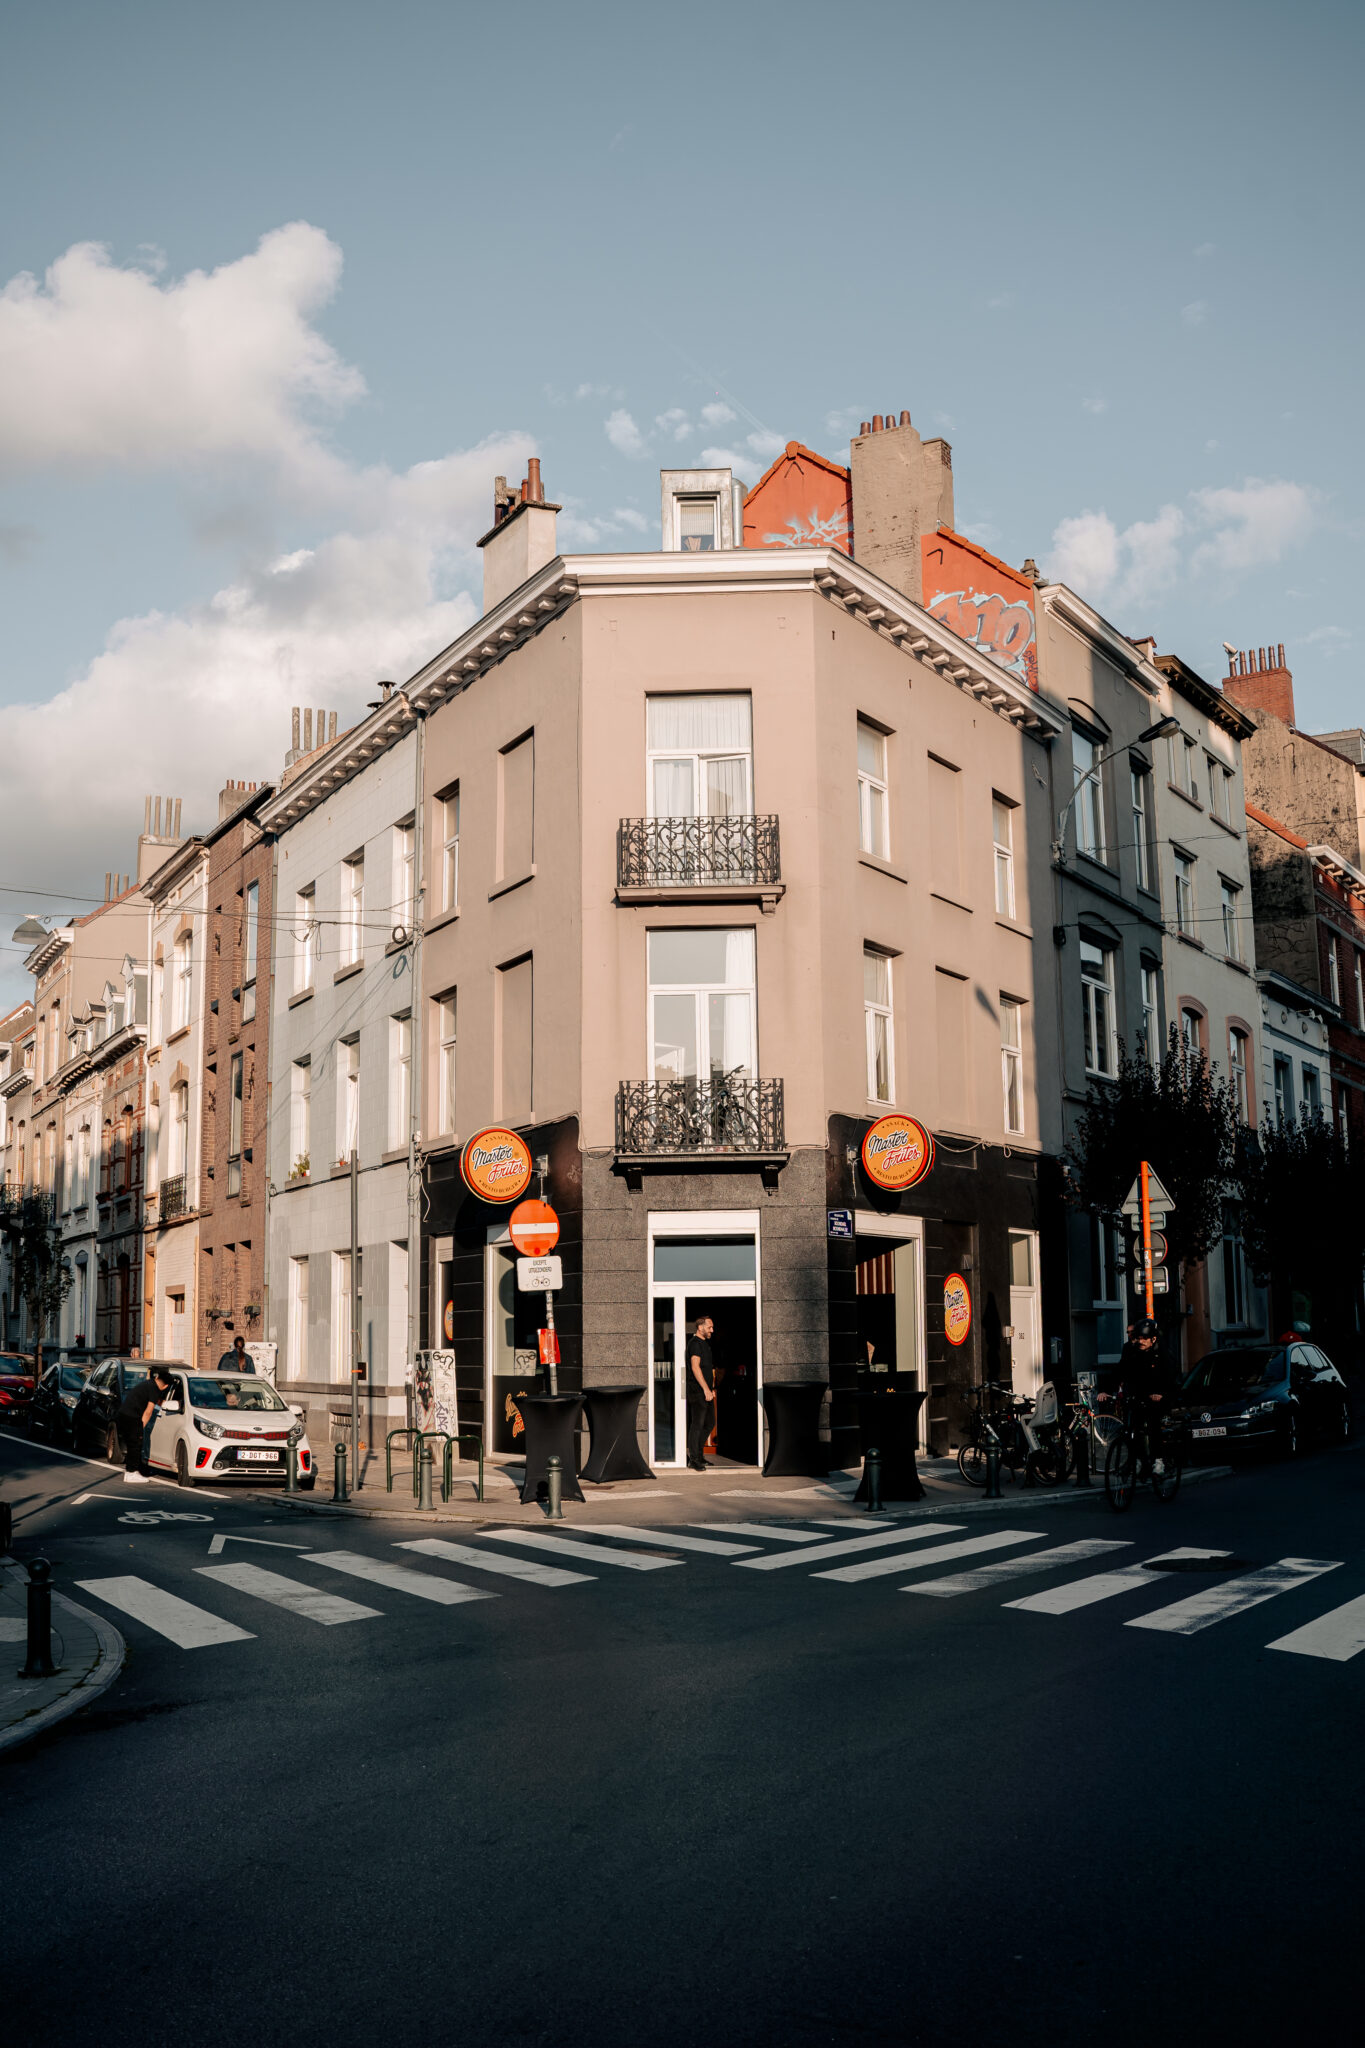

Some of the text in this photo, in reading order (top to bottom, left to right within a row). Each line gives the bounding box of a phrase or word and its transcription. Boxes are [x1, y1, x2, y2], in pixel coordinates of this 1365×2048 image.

[868, 1130, 909, 1158] Master
[882, 1143, 922, 1171] Frites
[472, 1145, 513, 1171] Master
[487, 1158, 527, 1183] Frites
